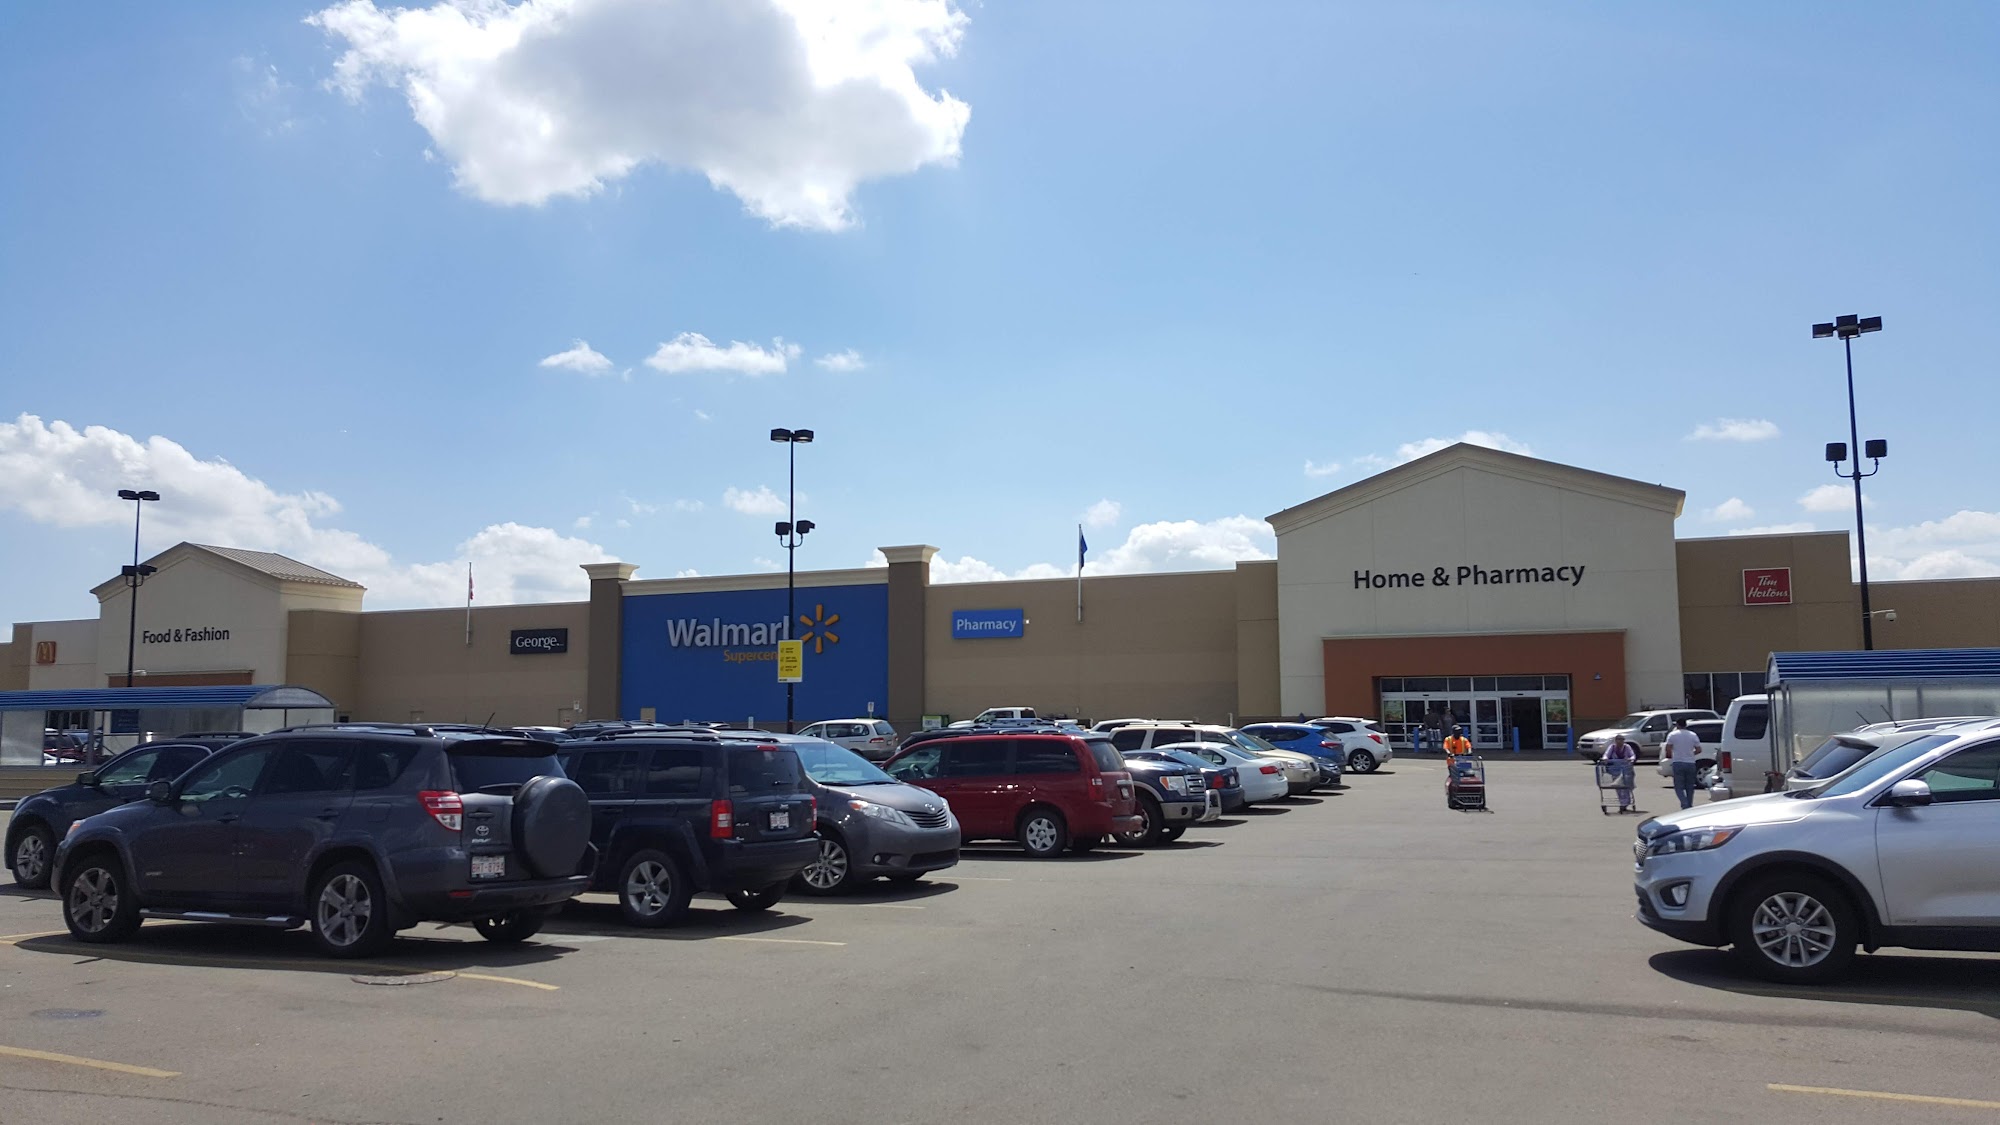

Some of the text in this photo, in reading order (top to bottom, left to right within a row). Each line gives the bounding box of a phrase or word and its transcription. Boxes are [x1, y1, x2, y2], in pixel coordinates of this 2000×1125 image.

[1353, 564, 1586, 589] Home & Pharmacy
[1757, 574, 1778, 587] Tim
[1747, 586, 1788, 598] Hortons
[956, 618, 1017, 633] Pharmacy
[142, 626, 230, 644] Food & Fashion
[723, 650, 779, 664] Supercen
